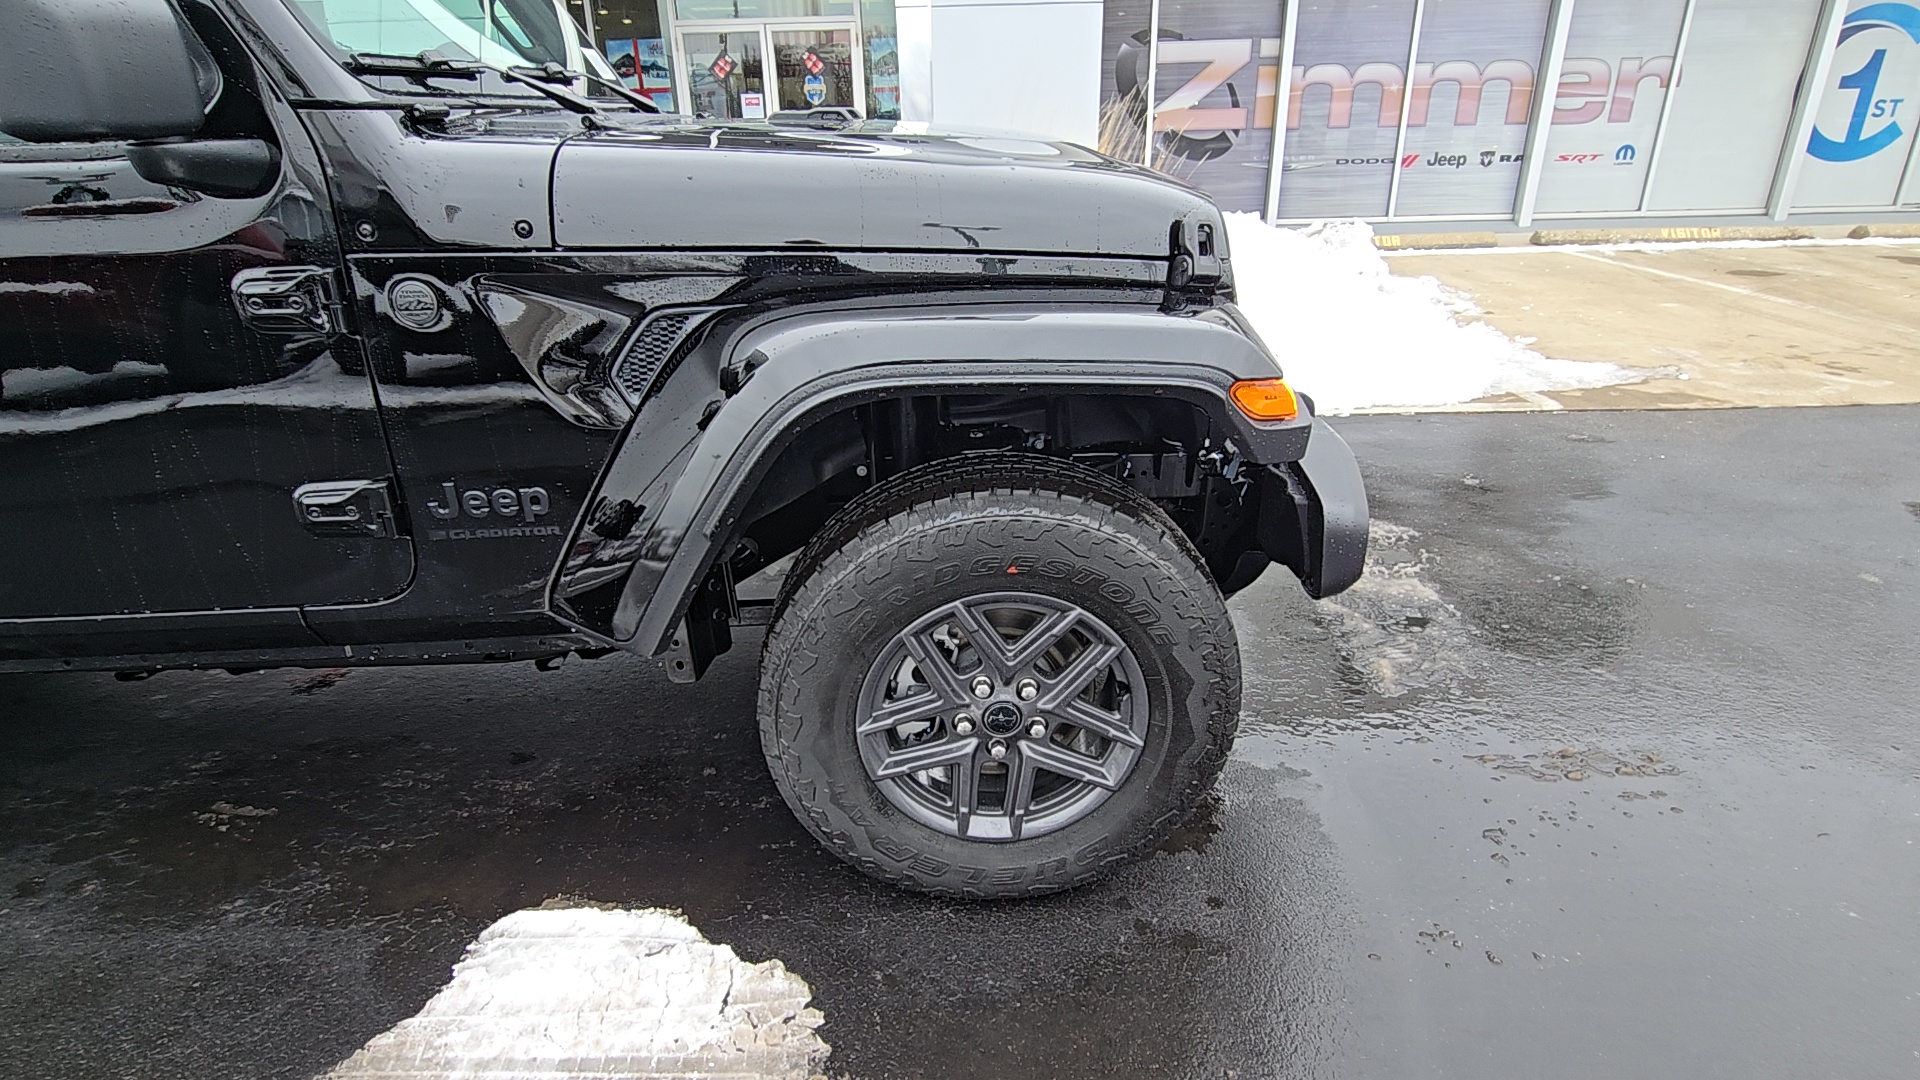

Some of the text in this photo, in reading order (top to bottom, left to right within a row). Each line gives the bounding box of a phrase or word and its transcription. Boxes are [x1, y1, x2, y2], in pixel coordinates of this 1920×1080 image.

[1152, 38, 1682, 131] Zimmer
[1336, 157, 1395, 166] DODG
[1426, 151, 1468, 169] Jeep
[1499, 154, 1525, 163] RA
[1554, 153, 1605, 164] SRT
[1660, 227, 1721, 239] VISITOR
[426, 481, 550, 522] Jeep
[448, 525, 564, 540] GLADIATOR
[848, 553, 1179, 647] BRIDGESTONE
[872, 833, 1130, 886] DUELER
